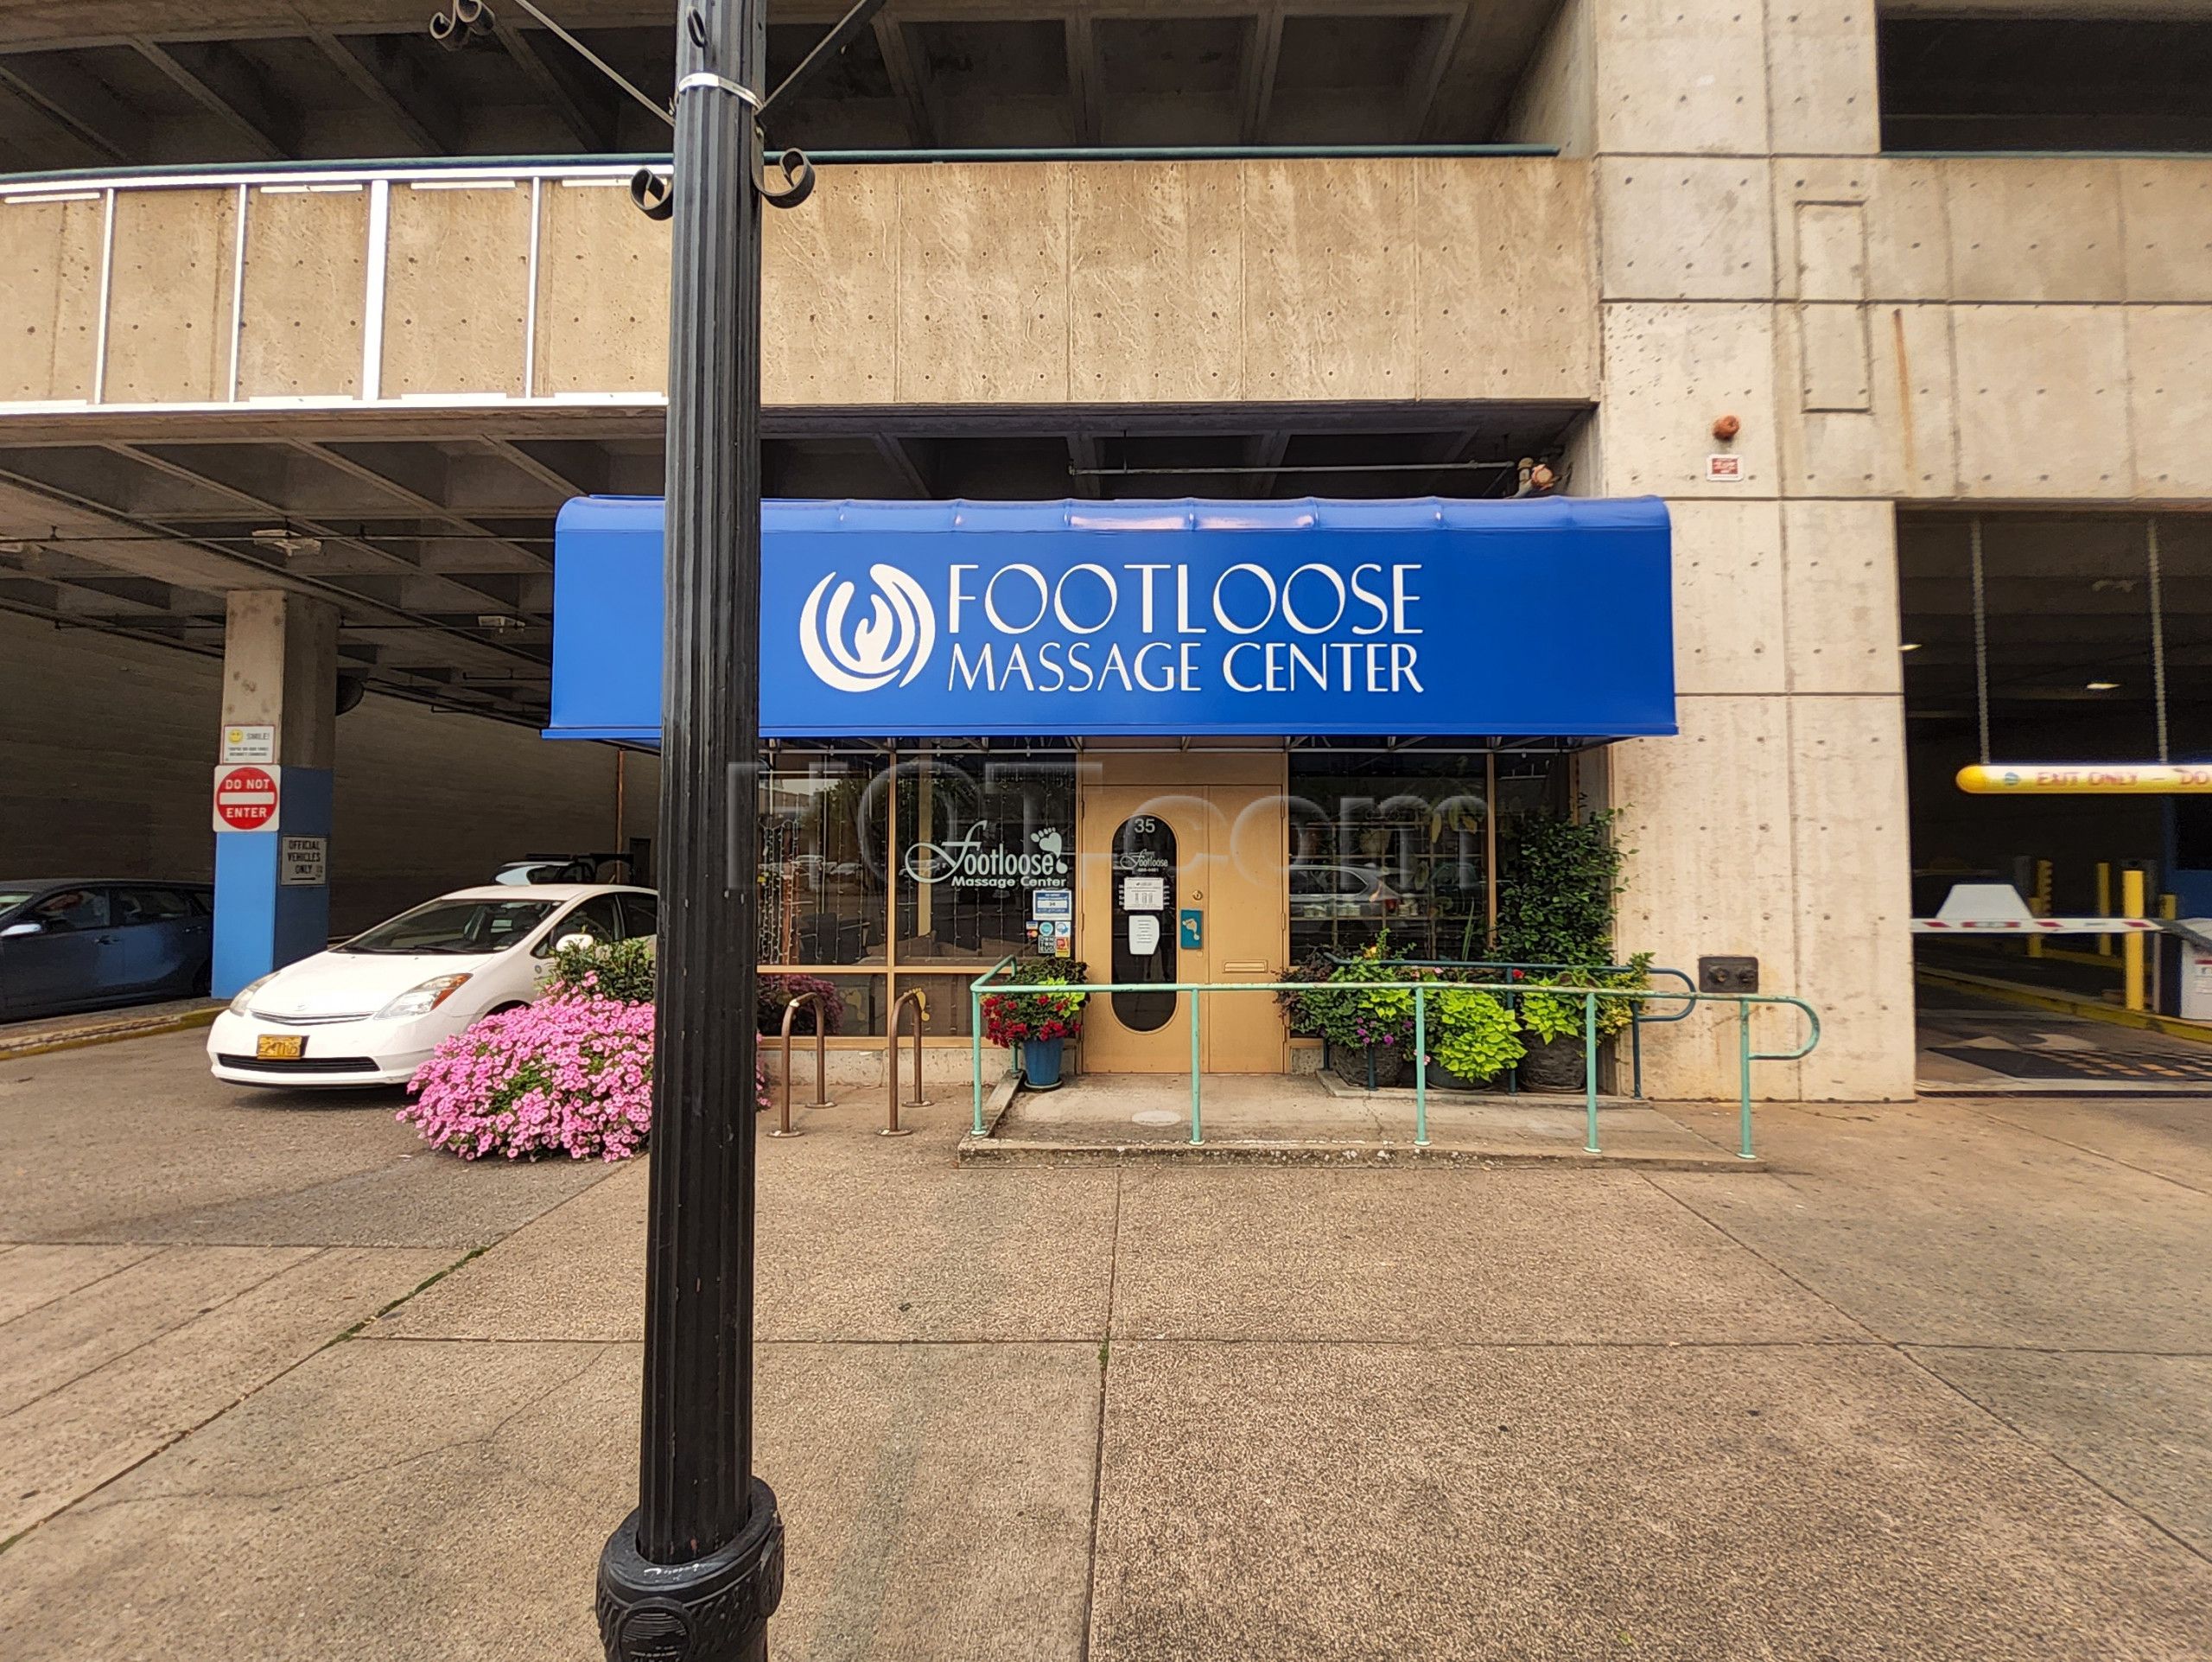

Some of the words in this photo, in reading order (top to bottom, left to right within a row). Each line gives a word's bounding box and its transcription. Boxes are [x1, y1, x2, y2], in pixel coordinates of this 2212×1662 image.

[949, 563, 1424, 635] FOOTLOOSE
[948, 641, 1202, 693] MASSAGE
[1222, 641, 1425, 693] CENTER
[225, 779, 242, 790] DO
[246, 779, 270, 789] NOT
[2036, 771, 2081, 786] EXIT
[2088, 771, 2139, 786] ONLY
[226, 807, 267, 818] ENTER
[1134, 818, 1156, 833] 35
[289, 840, 321, 850] OFFICIAL
[905, 819, 1054, 883] Footloose
[287, 852, 321, 862] VEHICLES
[295, 864, 313, 874] ONLY
[951, 876, 1016, 888] Massage
[1020, 876, 1067, 888] Center
